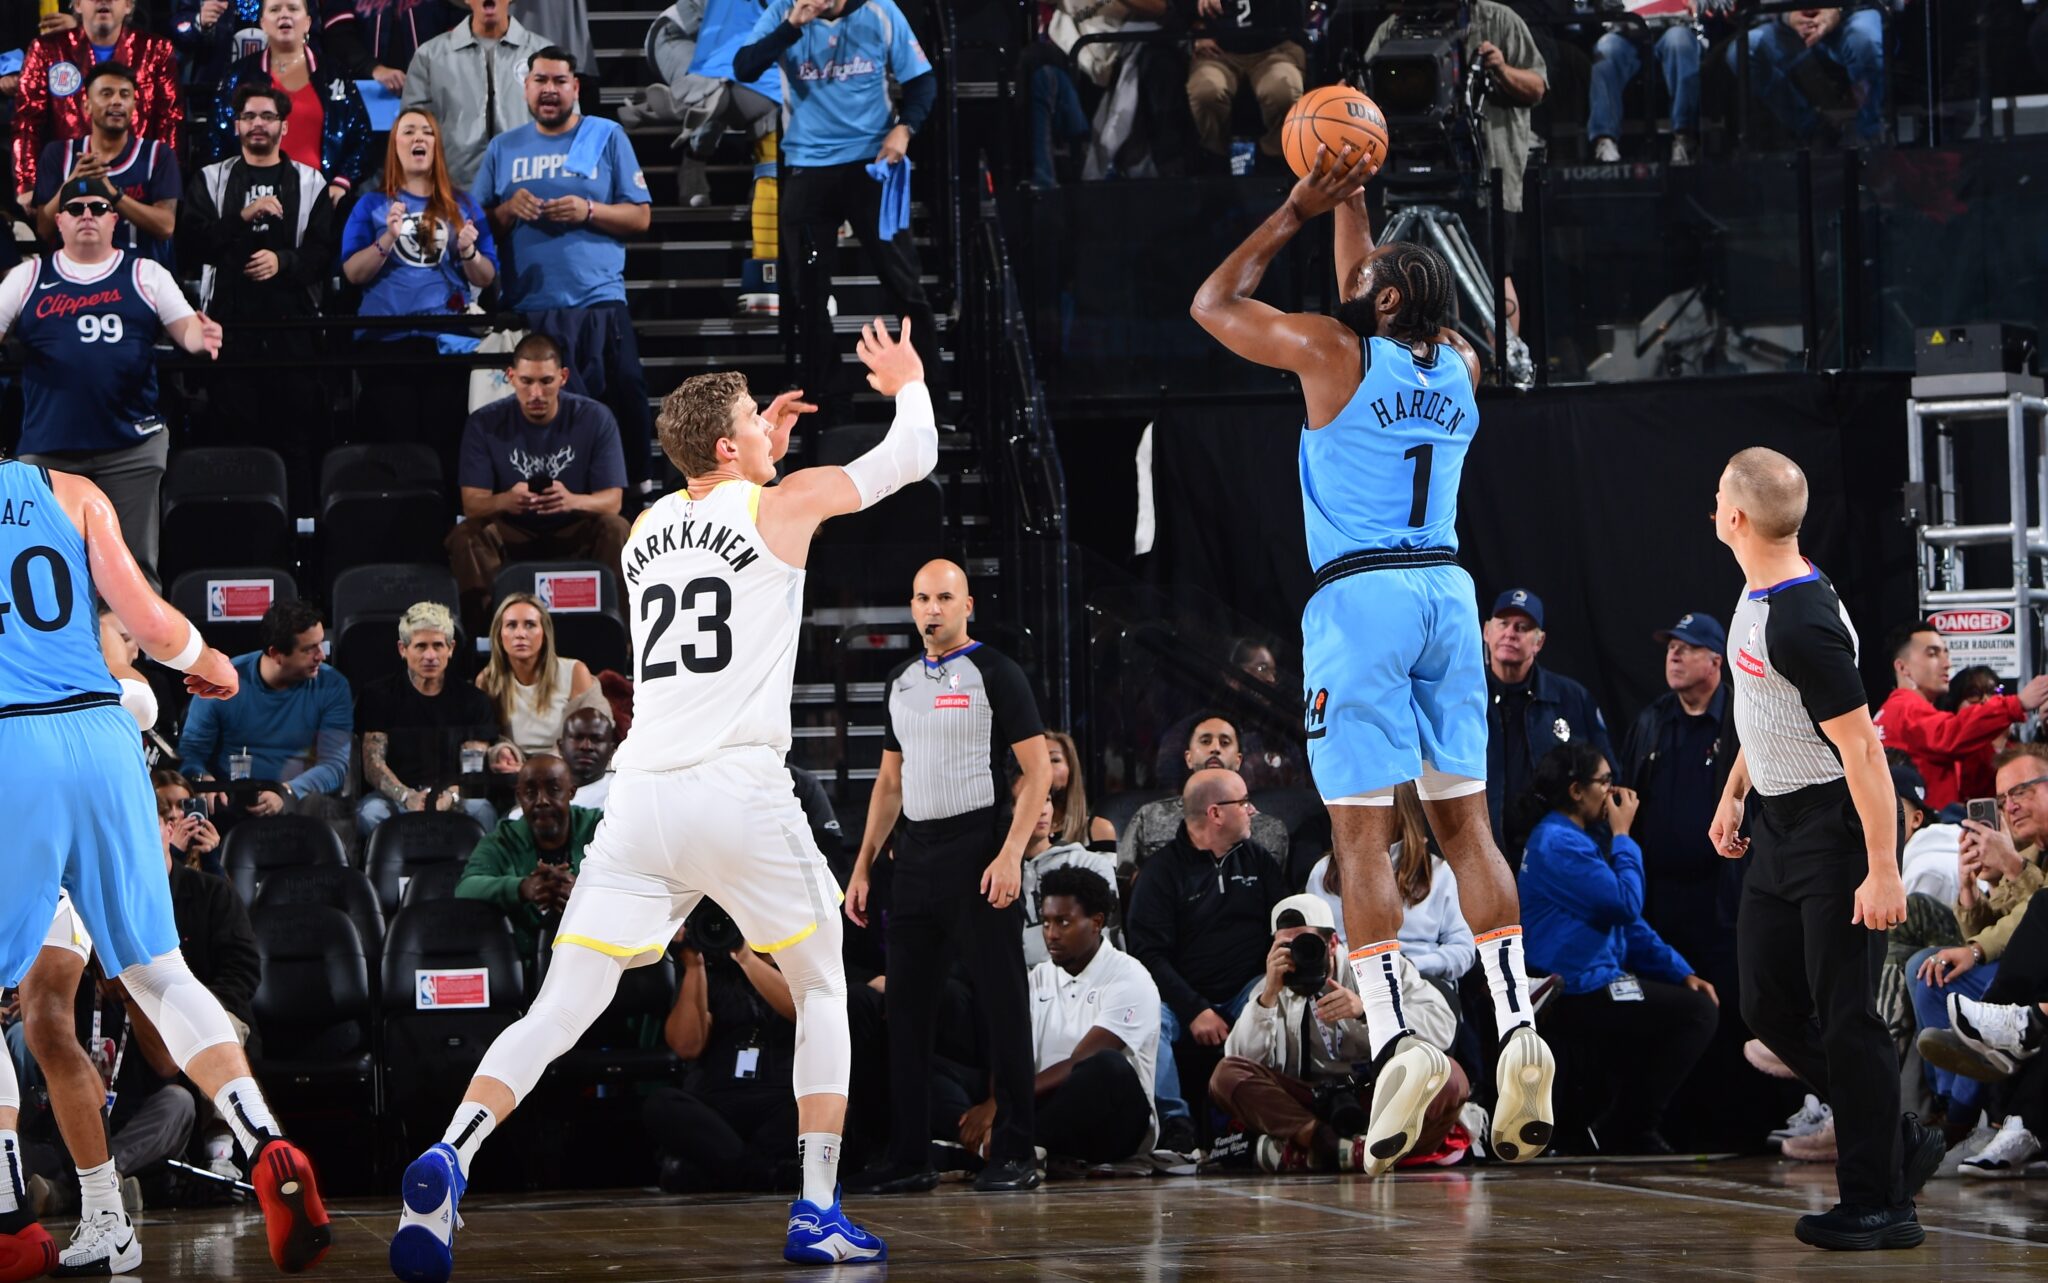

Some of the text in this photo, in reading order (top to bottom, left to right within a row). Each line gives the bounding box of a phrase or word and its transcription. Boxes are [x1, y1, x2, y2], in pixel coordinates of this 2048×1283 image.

[1237, 0, 1252, 27] 2
[821, 57, 873, 80] Angeles
[512, 154, 598, 183] CLIPP
[36, 288, 122, 319] Clippers
[77, 313, 124, 343] 99
[1370, 389, 1465, 436] HARDEN
[1403, 443, 1434, 528] 1
[1, 498, 35, 527] AC
[626, 520, 760, 586] MARKKANEN
[640, 576, 733, 684] 23
[1935, 613, 2003, 630] DANGER
[1948, 639, 2015, 650] ASER RADIATION
[936, 698, 969, 706] Emirates
